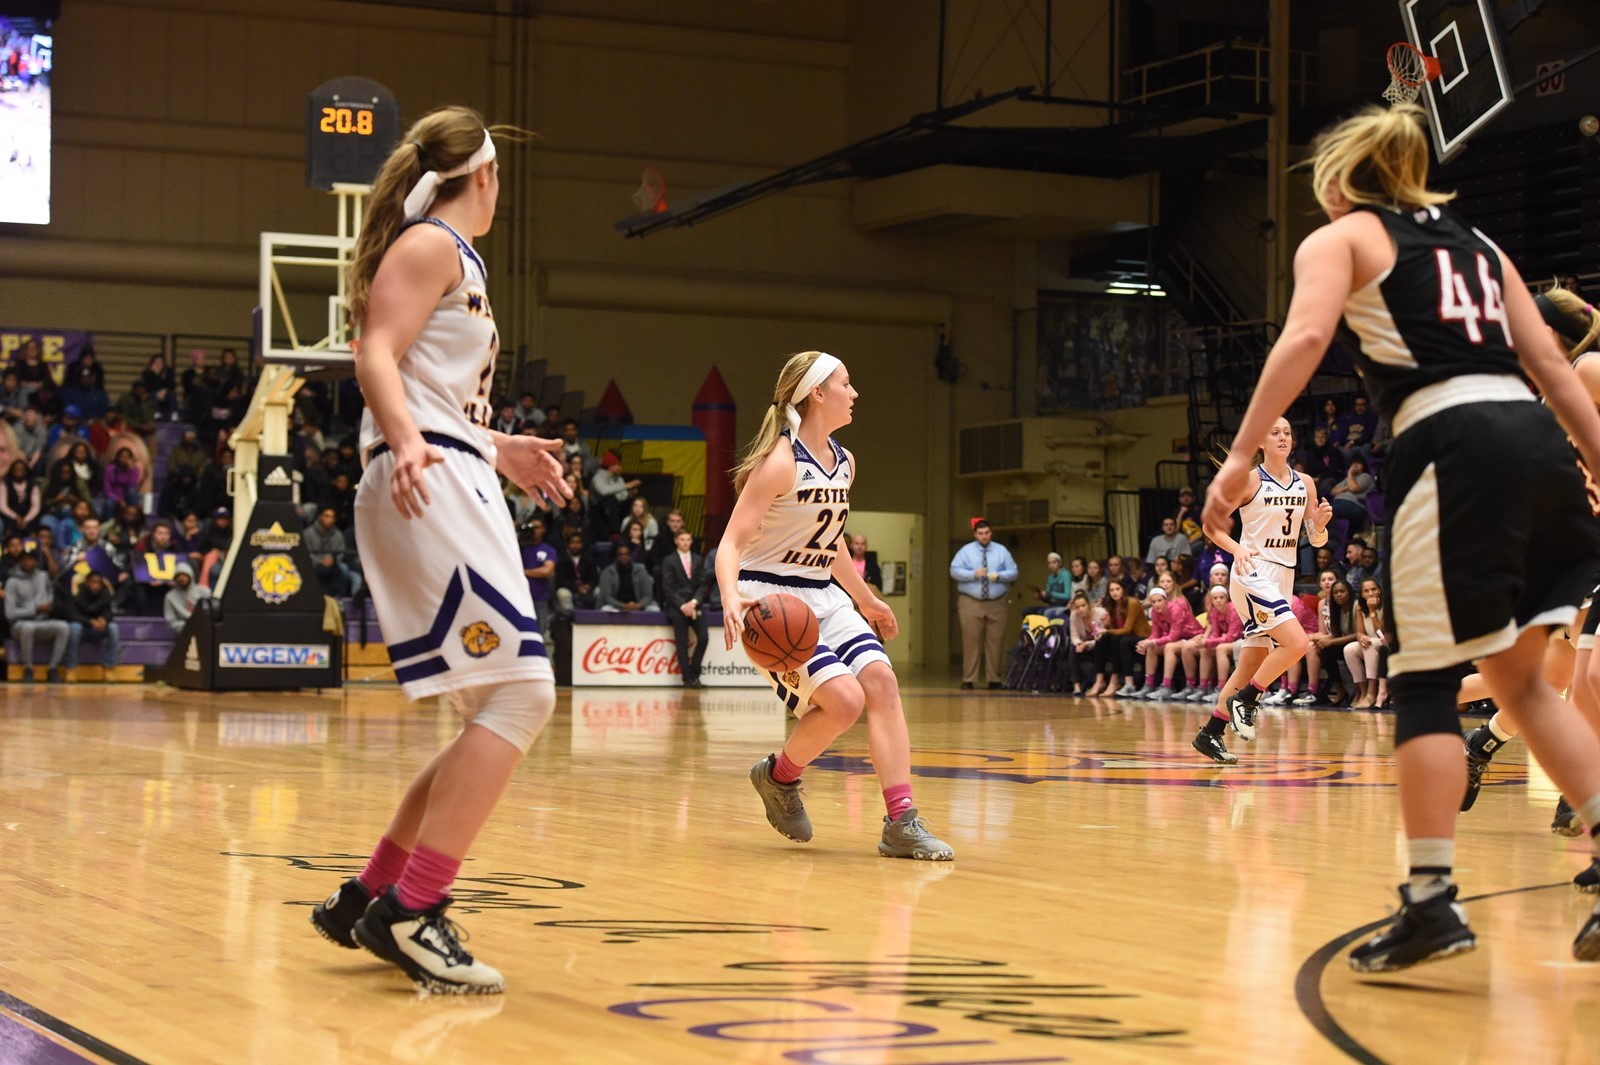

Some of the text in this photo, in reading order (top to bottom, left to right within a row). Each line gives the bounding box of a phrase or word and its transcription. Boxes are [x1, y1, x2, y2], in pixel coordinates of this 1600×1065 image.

[320, 107, 373, 136] 20.8
[1434, 247, 1513, 349] 44
[804, 508, 849, 552] 22
[1281, 508, 1295, 536] 3
[143, 552, 177, 580] U
[223, 646, 310, 665] WGEM
